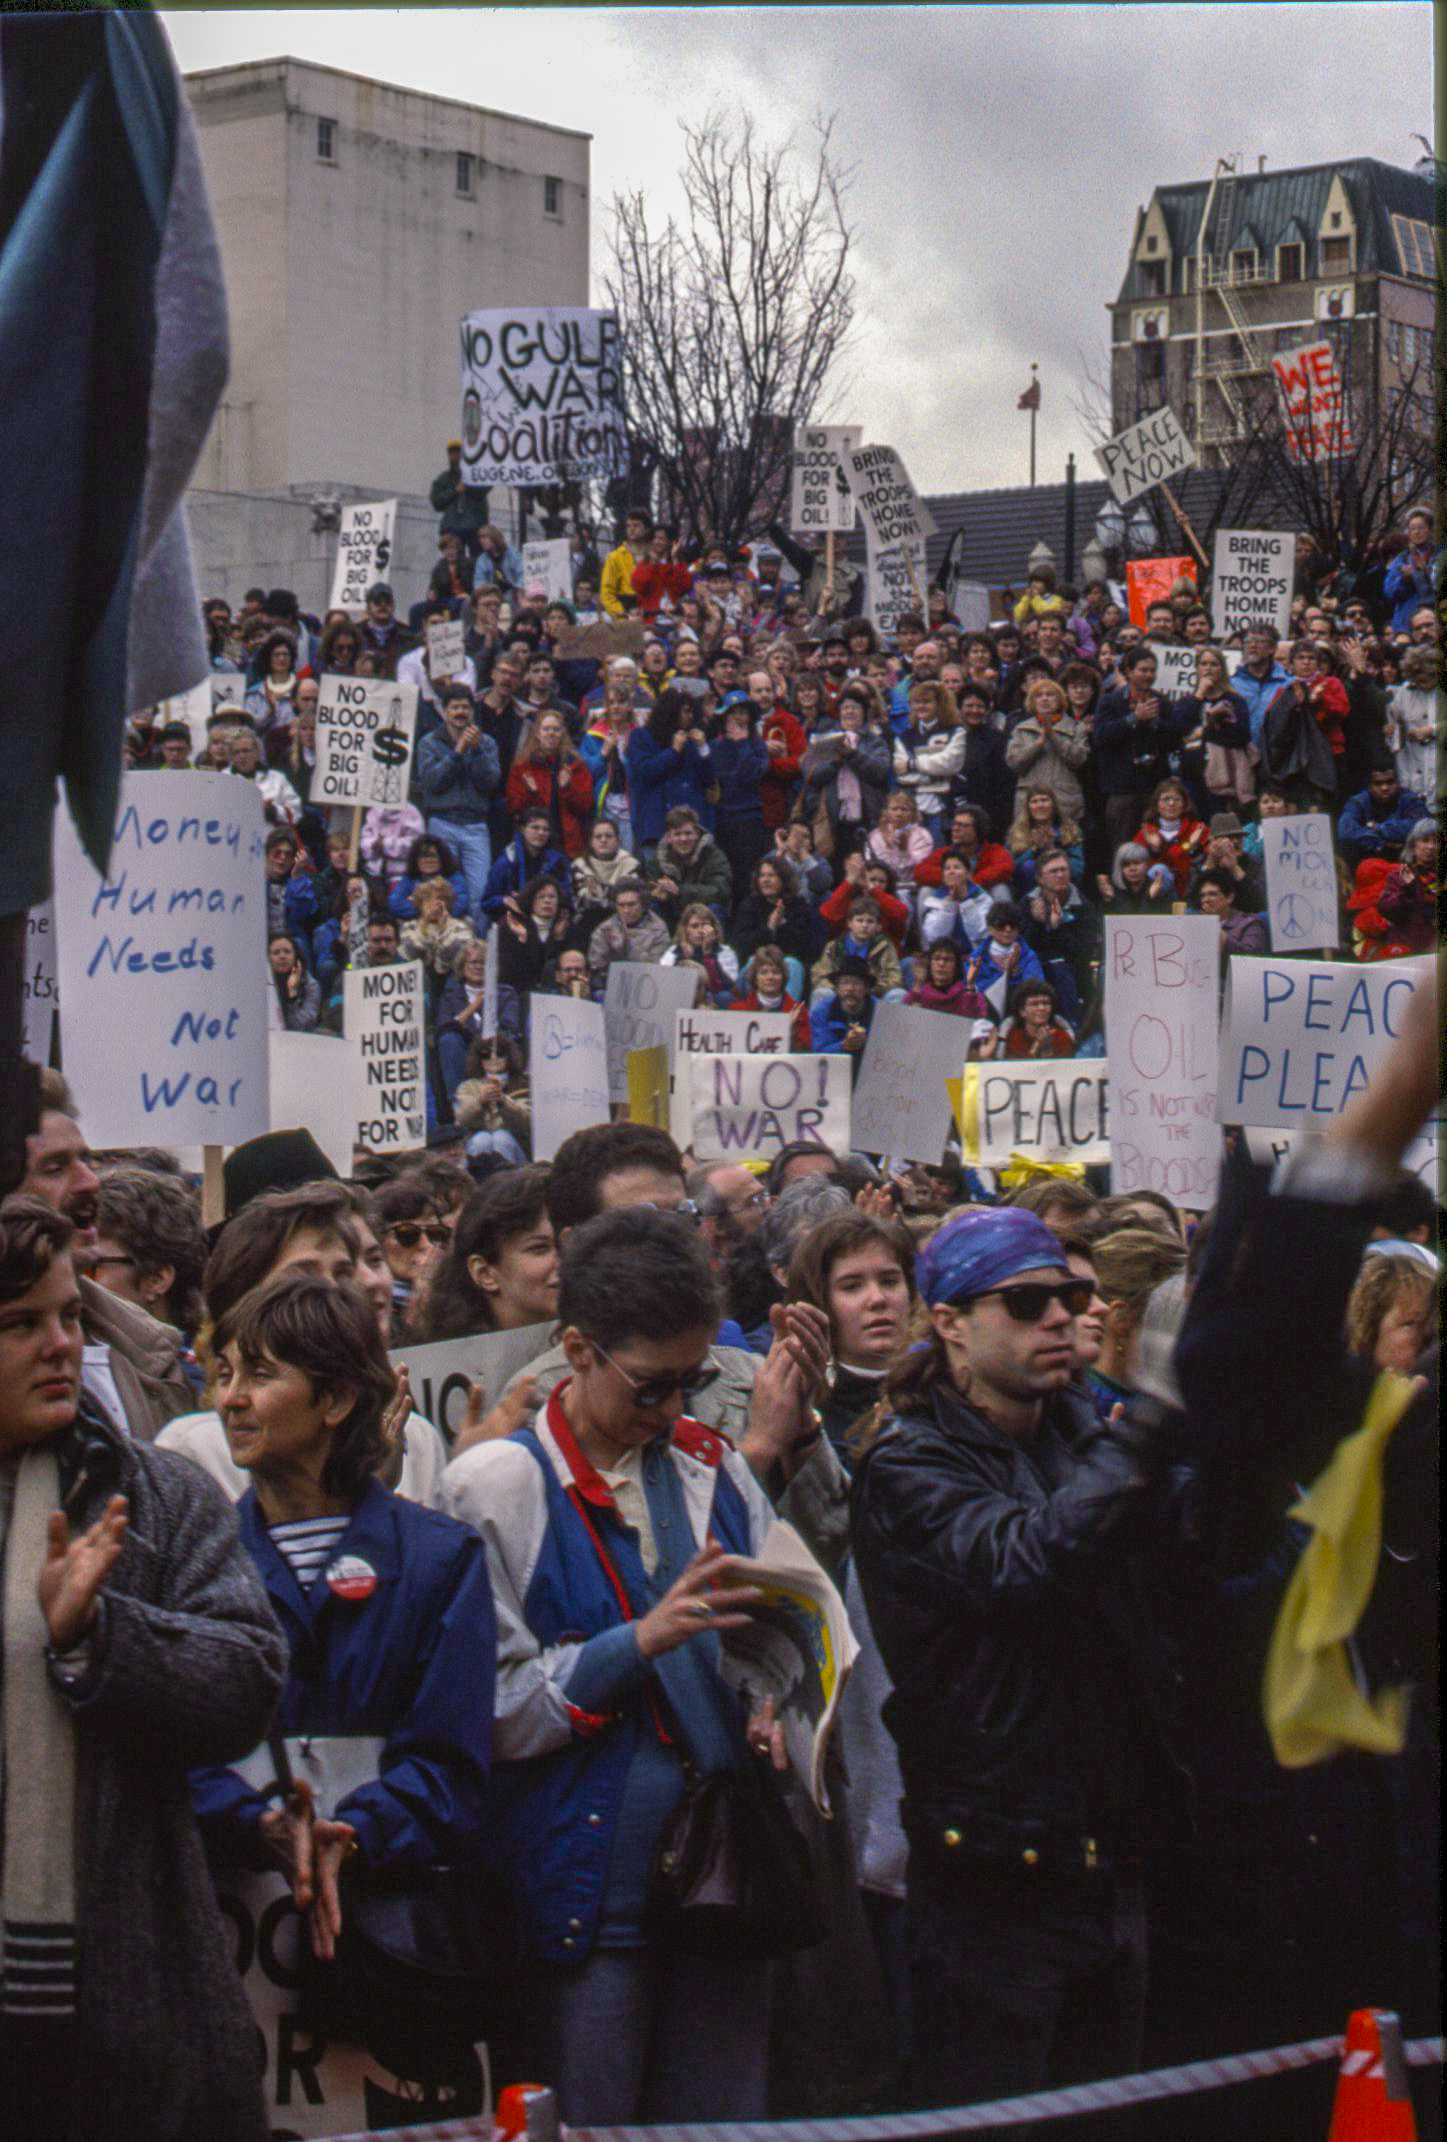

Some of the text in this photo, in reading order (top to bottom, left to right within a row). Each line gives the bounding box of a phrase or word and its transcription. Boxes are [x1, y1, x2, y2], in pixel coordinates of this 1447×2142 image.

[499, 320, 618, 369] GULF
[1273, 346, 1340, 393] WE
[498, 365, 622, 413] WAR
[806, 432, 828, 446] NO
[1102, 411, 1179, 475] PEACE
[796, 452, 838, 468] BLOOD
[851, 449, 895, 472] BRING
[1122, 441, 1184, 496] NOW
[802, 470, 830, 486] FOR
[865, 467, 894, 486] THE
[804, 490, 828, 505] BIG
[859, 484, 913, 510] TROOPS
[353, 511, 373, 527] NO
[801, 511, 830, 525] OIL!
[871, 503, 914, 526] HOME
[341, 529, 379, 547] BLOOD
[877, 522, 921, 544] NOW!
[346, 549, 371, 565] FOR
[1229, 537, 1281, 555] BRING
[346, 568, 368, 584] BIG
[1237, 557, 1270, 574] THE
[1218, 575, 1287, 594] TROOPS
[1224, 597, 1278, 614] HOME
[337, 685, 366, 704] NO
[318, 705, 379, 729] BLOOD
[327, 731, 365, 752] FOR
[329, 753, 359, 773] BIG
[323, 776, 359, 797] OIL!
[1283, 822, 1321, 848] NO
[91, 871, 244, 919] Human
[87, 936, 215, 978] Needs
[170, 1008, 240, 1047] Not
[1129, 1013, 1207, 1080] OIL
[140, 1072, 242, 1114] War
[714, 1059, 830, 1108] NO!
[1149, 1092, 1193, 1120] NOT
[358, 1119, 399, 1146] FOR
[713, 1109, 824, 1150] WAR
